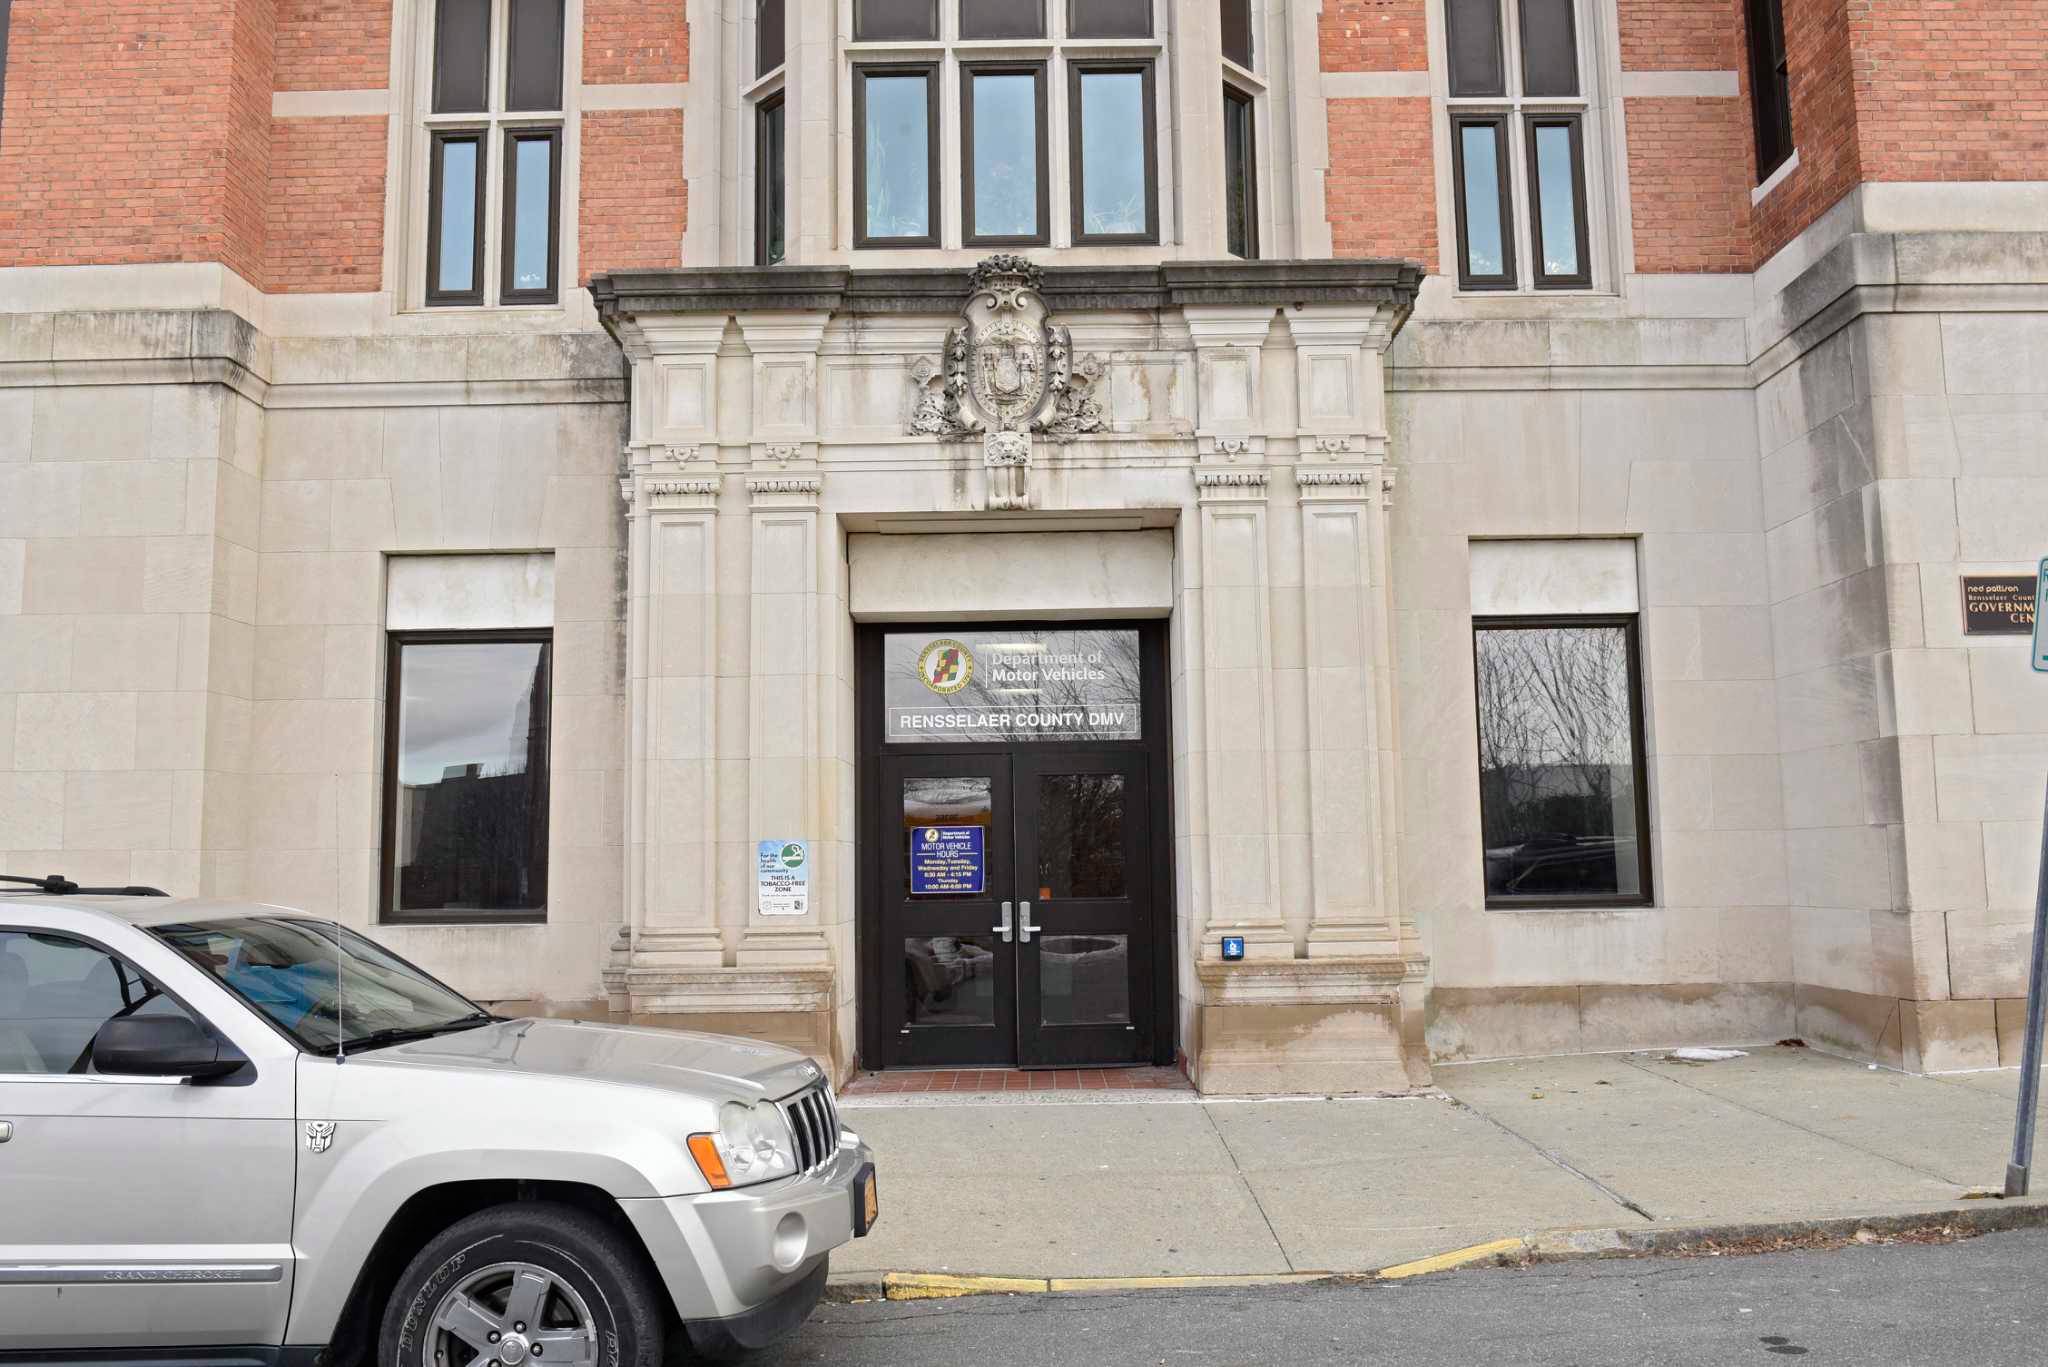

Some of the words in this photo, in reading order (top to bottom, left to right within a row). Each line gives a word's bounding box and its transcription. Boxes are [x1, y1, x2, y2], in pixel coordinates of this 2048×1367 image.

[1986, 585, 2018, 593] pattison
[1969, 602, 2034, 612] GOVERNM
[2010, 613, 2034, 623] CEN
[992, 652, 1083, 668] Department
[1087, 650, 1103, 663] of
[992, 669, 1038, 681] Motor
[1041, 667, 1105, 681] Vehicles
[900, 713, 1010, 728] RENSSELAER
[1015, 713, 1083, 727] COUNTY
[1089, 713, 1124, 726] DMV
[921, 842, 945, 851] MOTOR
[946, 842, 972, 850] VEHICLE
[936, 850, 959, 858] HOURS
[103, 1270, 157, 1280] GRAND
[162, 1270, 241, 1279] CHEROKEE
[399, 1254, 466, 1352] DUNLOP
